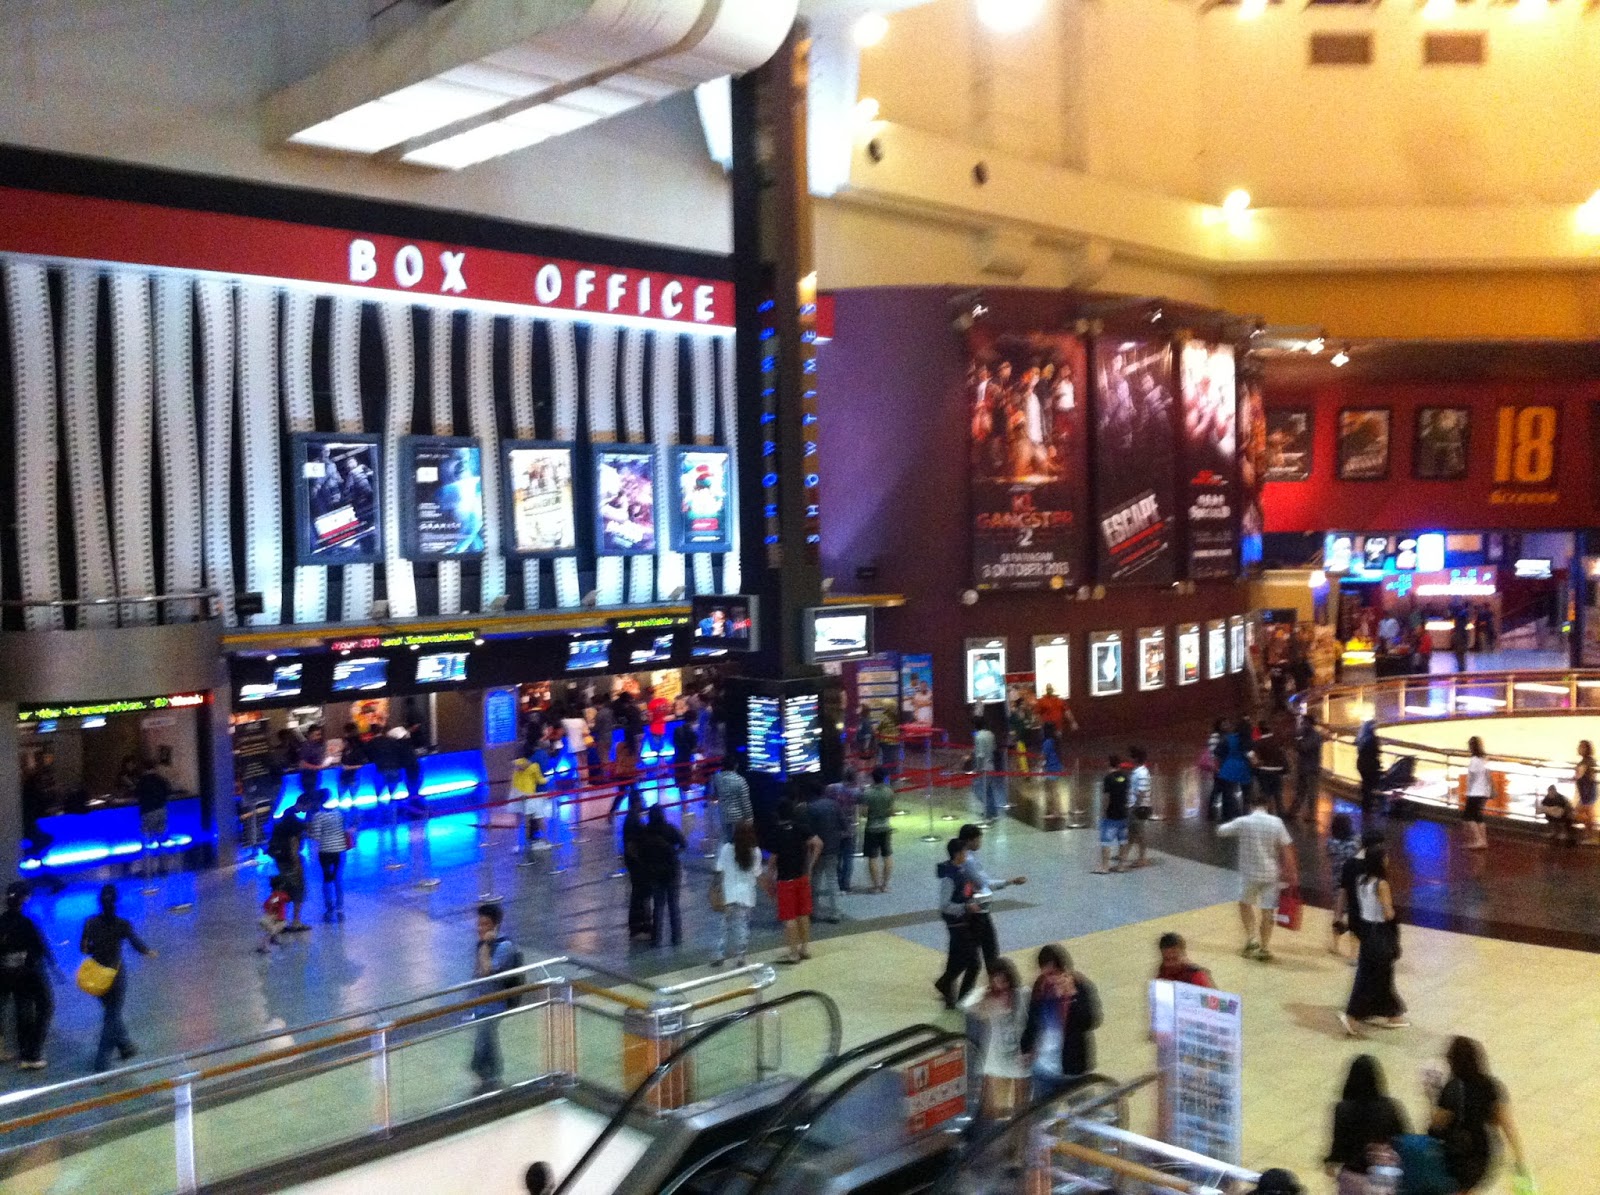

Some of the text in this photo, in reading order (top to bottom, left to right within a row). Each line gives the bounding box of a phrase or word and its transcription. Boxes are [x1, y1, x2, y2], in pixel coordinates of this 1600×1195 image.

[348, 239, 714, 322] BOX OFFICE
[1494, 406, 1556, 482] 18
[976, 511, 1072, 529] GANGSTER
[1018, 528, 1034, 546] 2
